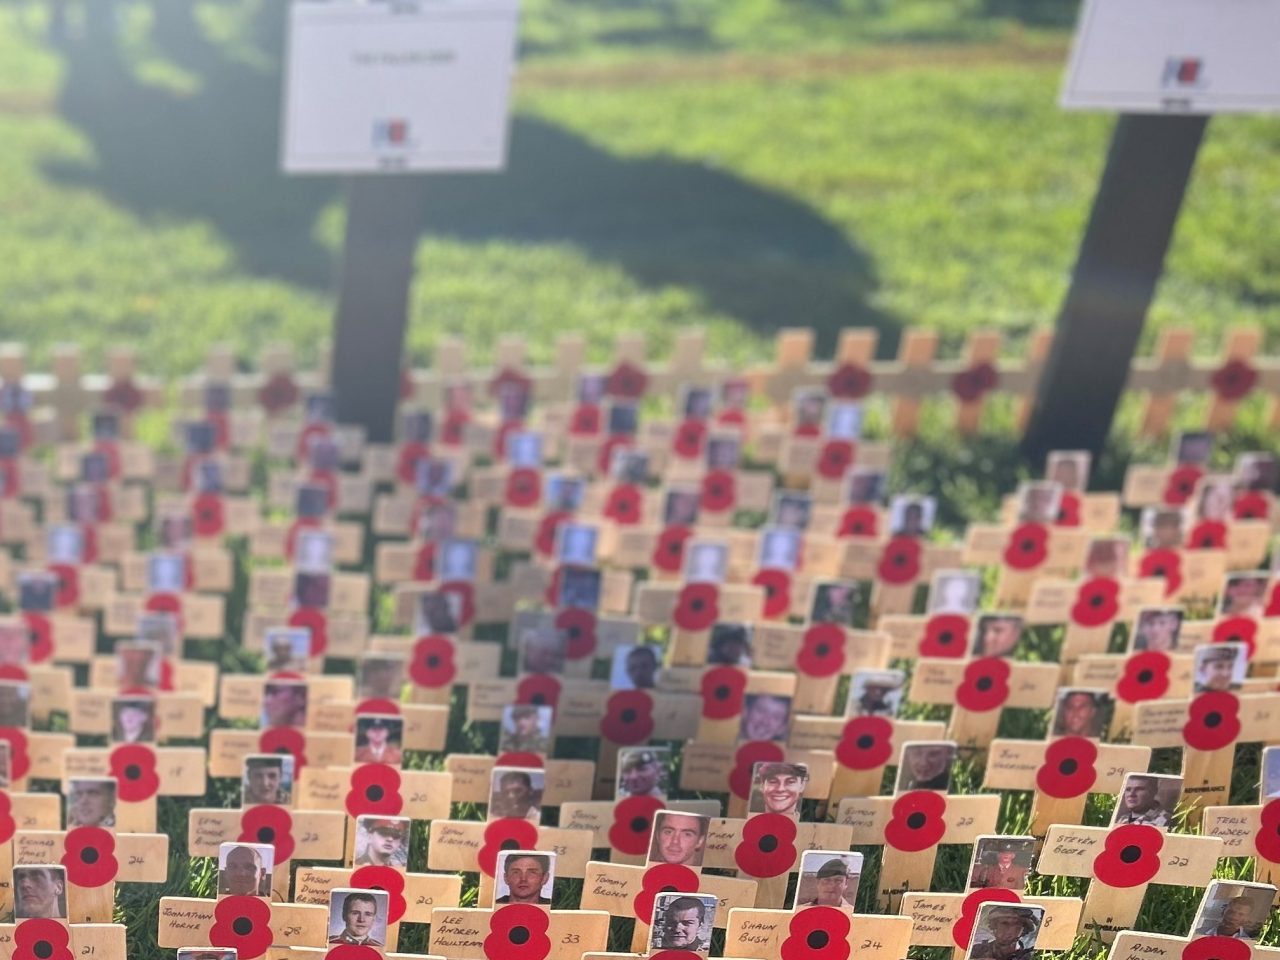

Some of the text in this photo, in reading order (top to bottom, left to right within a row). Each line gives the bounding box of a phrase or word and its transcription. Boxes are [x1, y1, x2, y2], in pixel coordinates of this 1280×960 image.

[1107, 767, 1124, 776] 29
[1185, 786, 1226, 794] REMEMBRANCE
[410, 793, 427, 802] 20
[956, 816, 973, 826] 22
[1056, 834, 1097, 845] STEVEN
[1053, 845, 1086, 856] BOOTE
[128, 856, 144, 866] 24
[1168, 857, 1189, 867] 22
[596, 873, 627, 887] TOMMY
[416, 895, 432, 905] 20
[912, 899, 945, 910] JAMES
[442, 916, 463, 924] LEE
[169, 920, 201, 931] HORNE
[741, 920, 777, 931] SHAUN
[283, 926, 302, 936] 28
[561, 933, 580, 944] 33
[738, 933, 770, 943] BUSH
[861, 940, 882, 949] 24
[1131, 943, 1167, 955] AIDAN
[82, 945, 94, 955] 21
